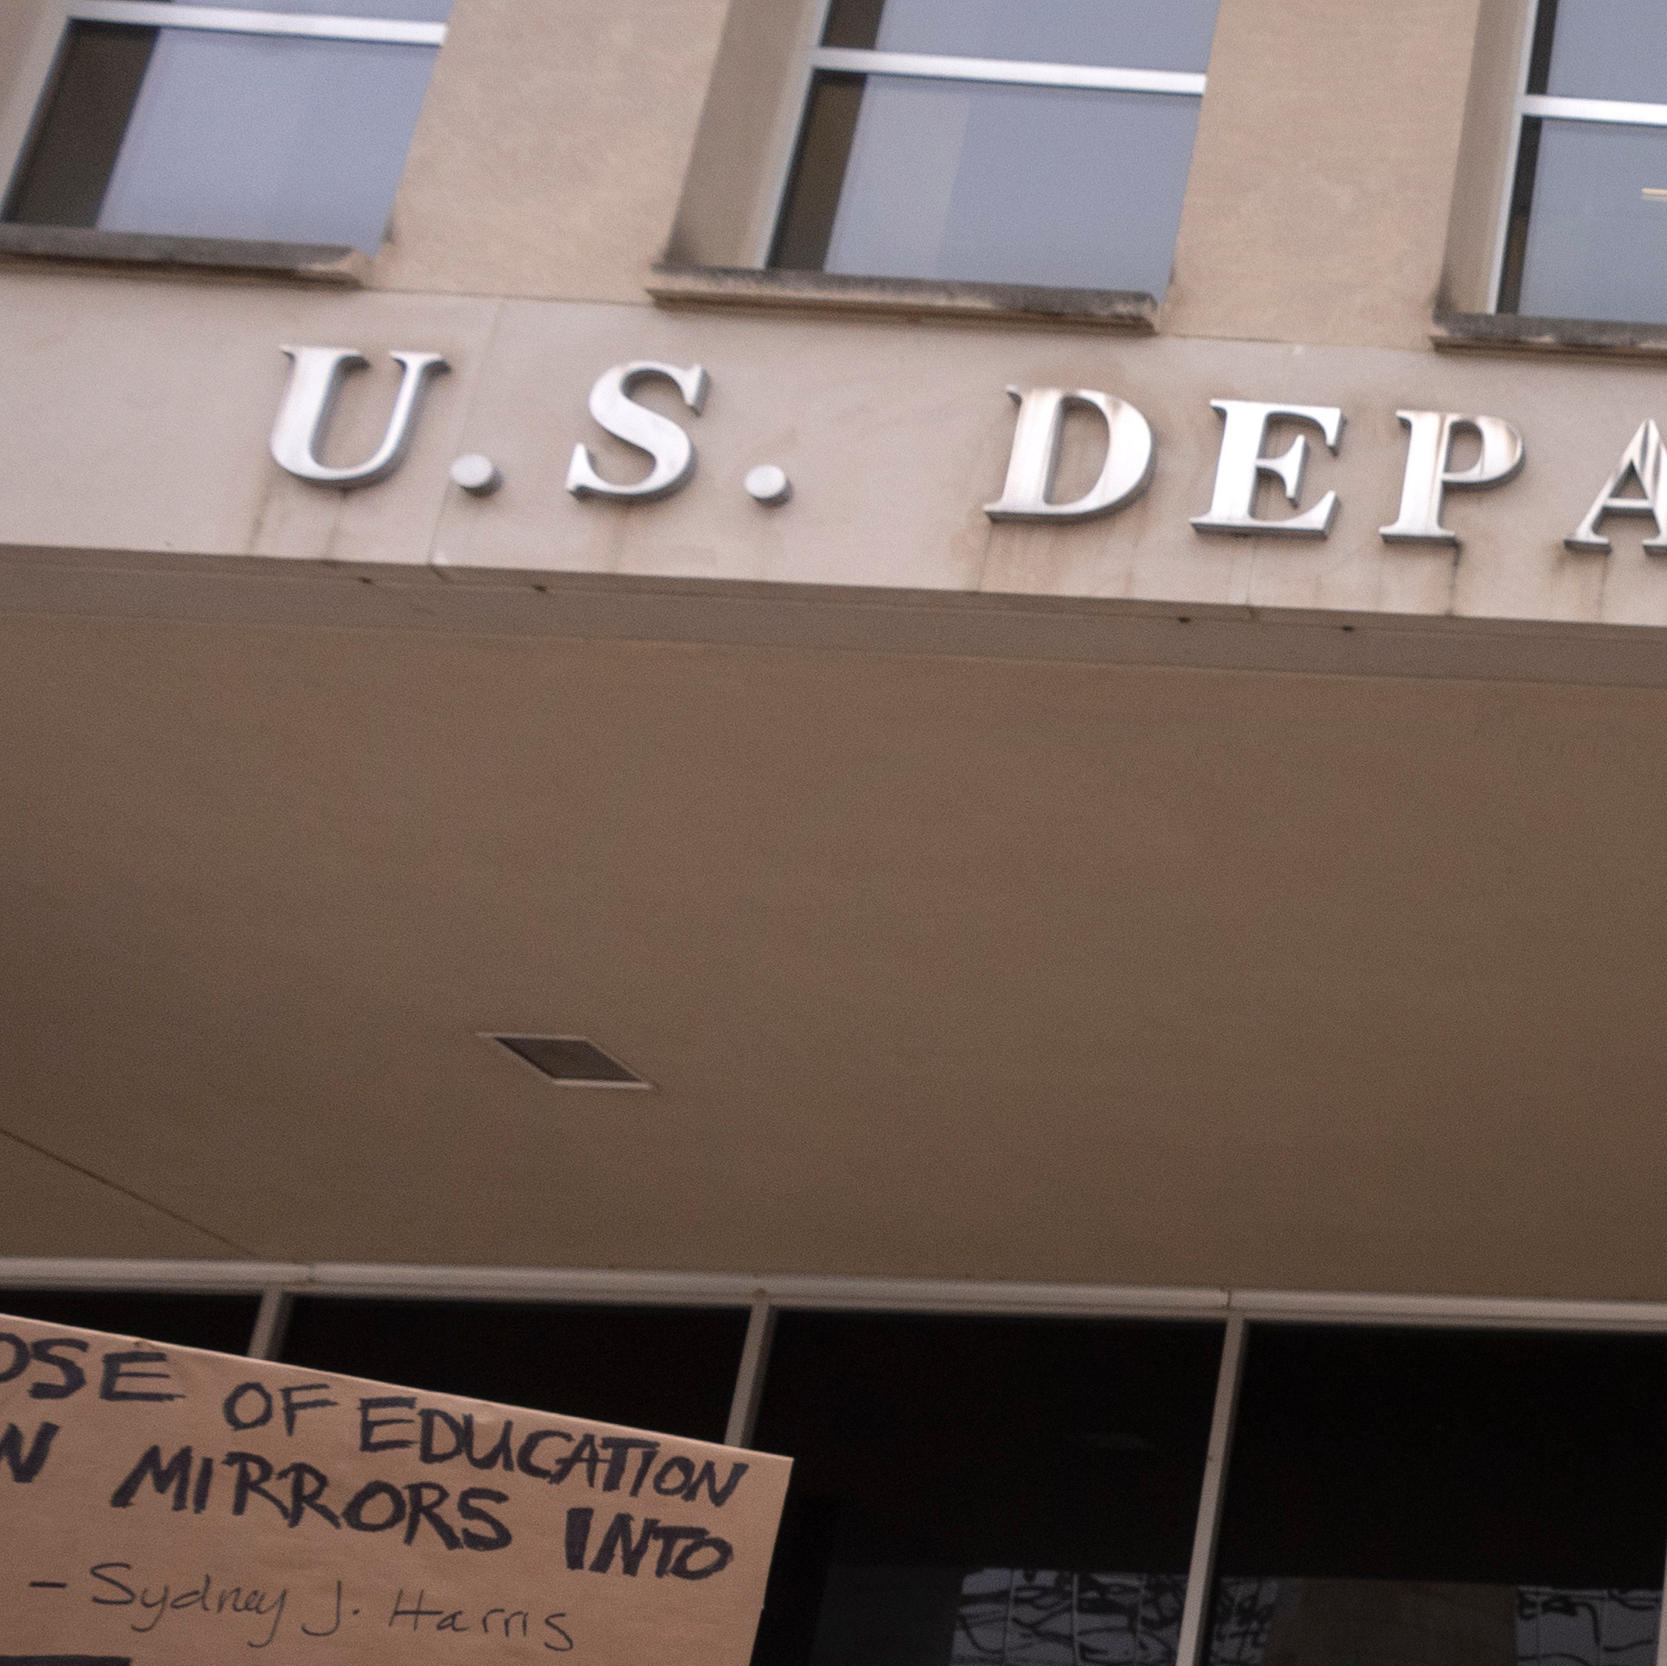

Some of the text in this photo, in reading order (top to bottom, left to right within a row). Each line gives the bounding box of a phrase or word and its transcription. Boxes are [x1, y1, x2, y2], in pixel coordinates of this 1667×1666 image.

[224, 1383, 339, 1436] OF
[358, 1396, 748, 1508] EDUCATION
[110, 1446, 511, 1551] MIRRORS
[564, 1508, 734, 1580] INTO
[89, 1563, 288, 1647] Sydney
[302, 1580, 360, 1637] J.
[388, 1582, 573, 1652] Harris
